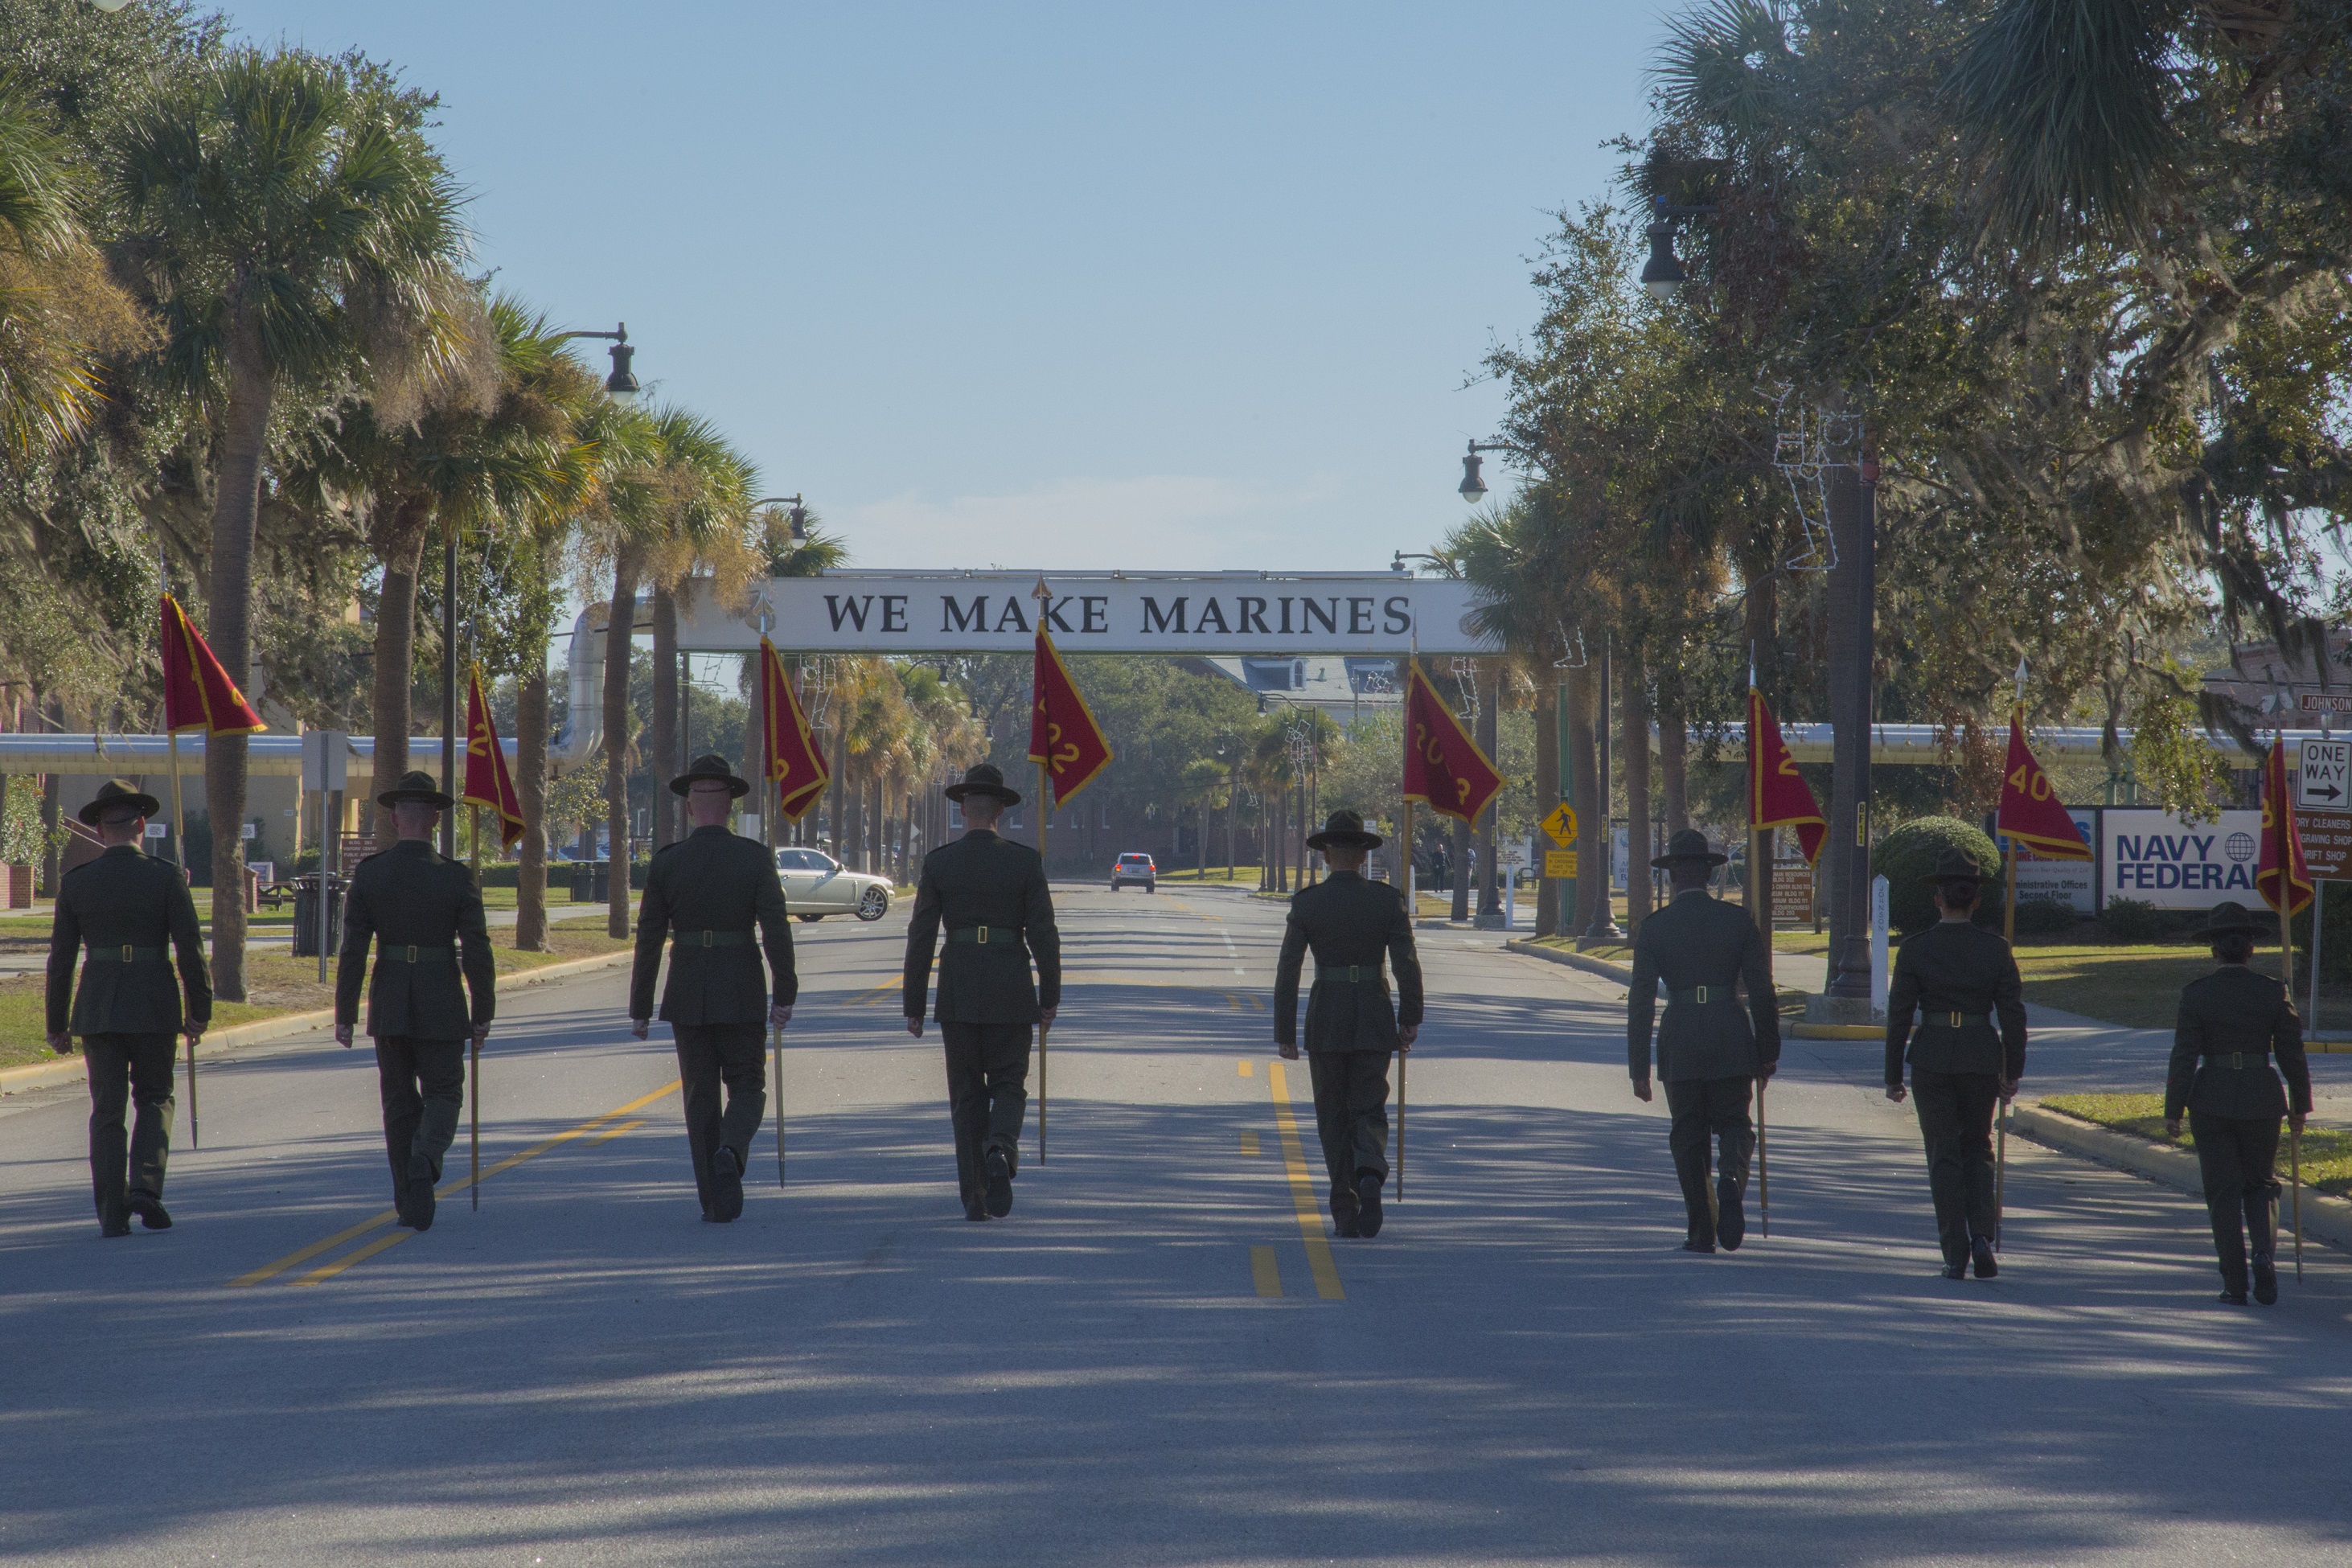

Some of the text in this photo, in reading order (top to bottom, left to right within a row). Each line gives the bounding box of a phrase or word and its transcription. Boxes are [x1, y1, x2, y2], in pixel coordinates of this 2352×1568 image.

[823, 595, 1412, 635] WE MAKE MARINES
[2304, 696, 2352, 712] JOHNSON
[2308, 745, 2346, 761] ONE
[2305, 764, 2346, 781] WAY
[2295, 817, 2351, 830] DRY CLEANERS
[2334, 835, 2352, 846] SHOP
[2116, 835, 2216, 861] NAVY
[2325, 851, 2347, 861] SHOP
[2061, 880, 2088, 889] Offices
[2018, 890, 2072, 900] Second Floor
